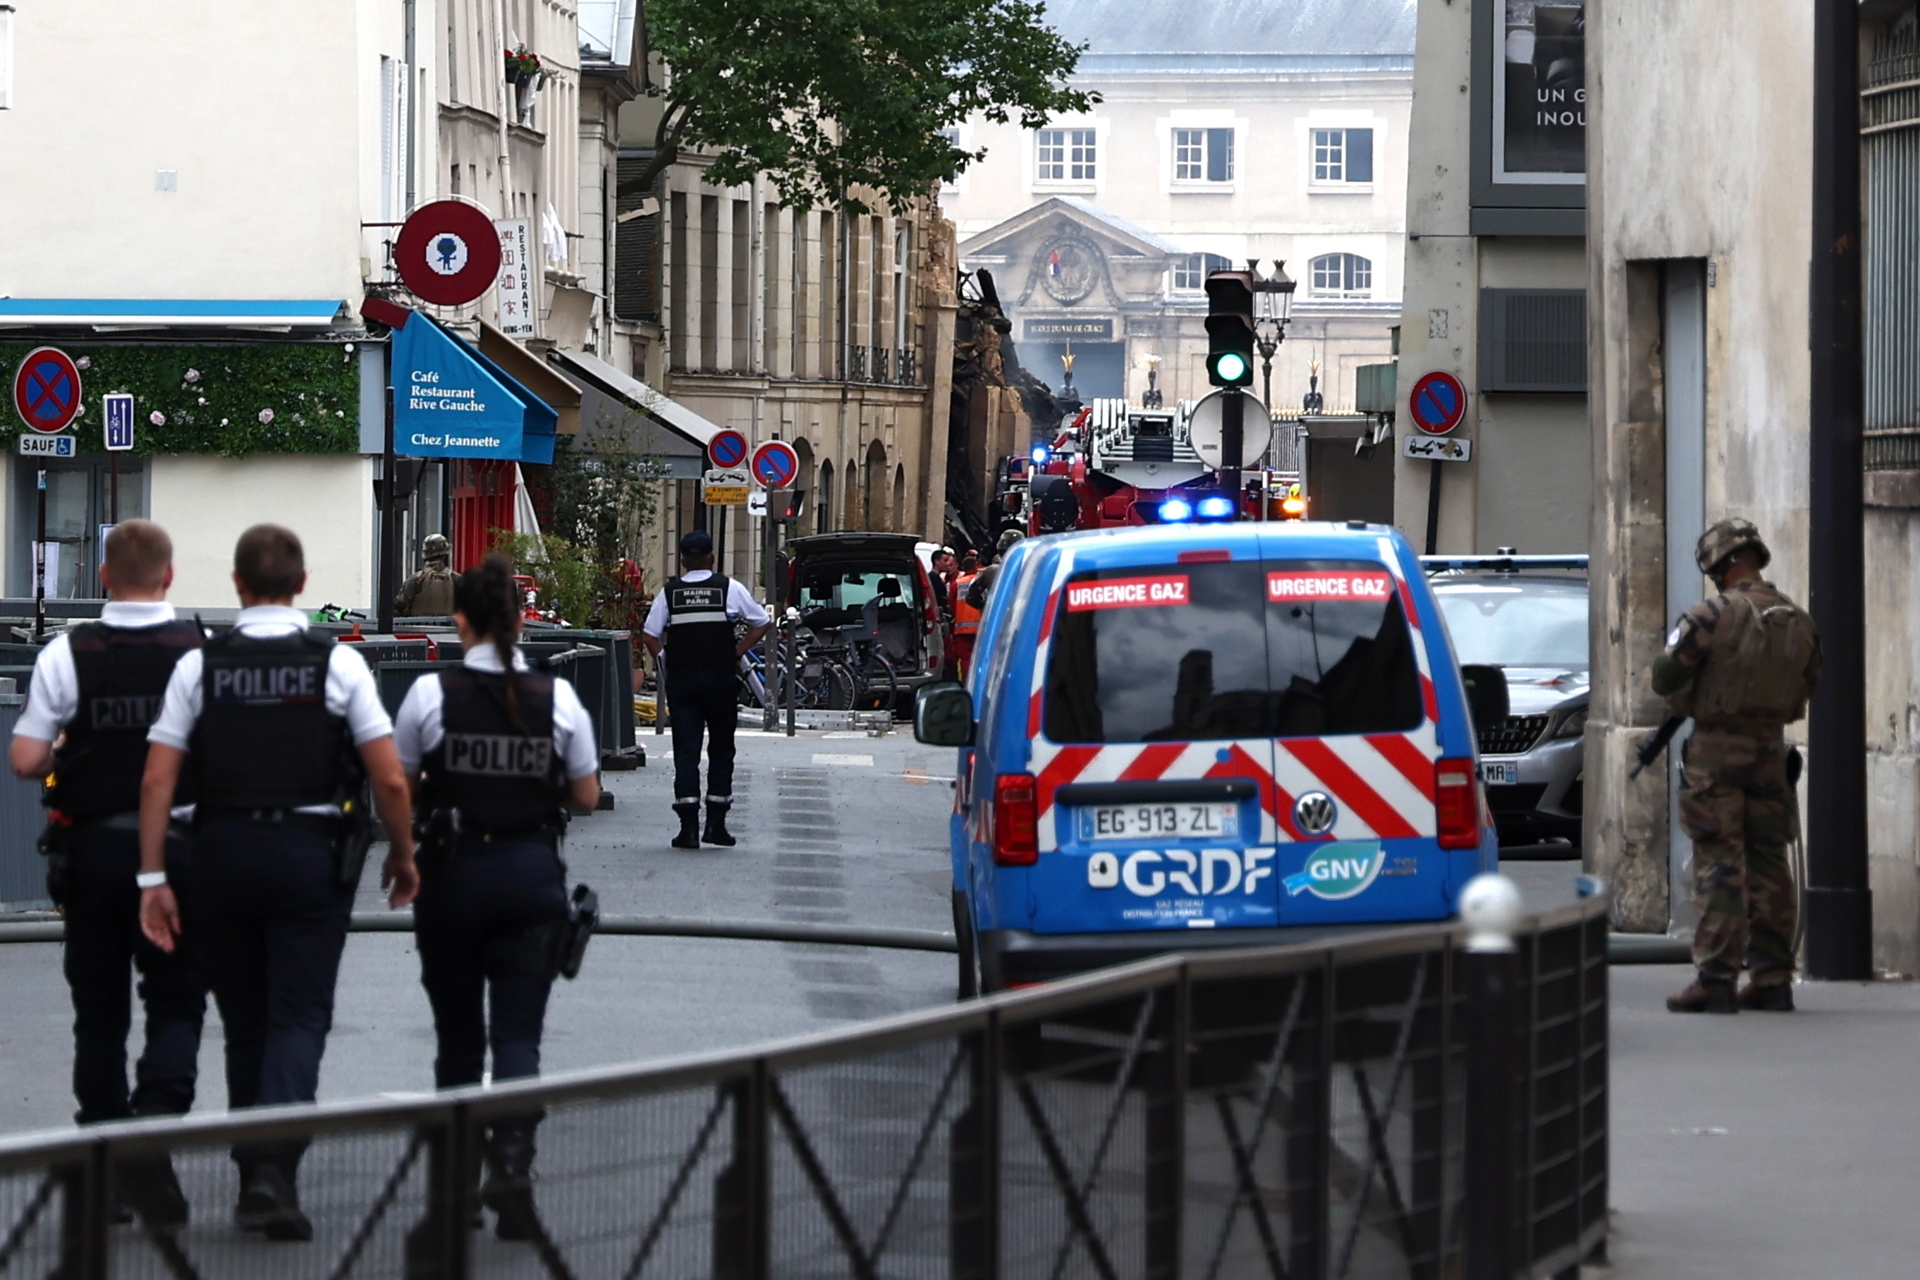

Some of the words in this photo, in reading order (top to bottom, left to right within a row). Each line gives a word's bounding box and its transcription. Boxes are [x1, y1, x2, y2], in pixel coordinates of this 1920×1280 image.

[1537, 88, 1565, 103] UN
[518, 225, 529, 318] RESTAURANT
[411, 371, 439, 383] Café
[411, 385, 475, 398] Restaurant
[409, 398, 437, 410] Rive
[439, 399, 486, 412] Gauche
[23, 439, 55, 451] SAUF
[411, 433, 442, 445] Chez
[443, 434, 500, 448] Jeannette
[1069, 584, 1146, 605] URGENCE
[1150, 582, 1184, 600] GAZ
[1270, 578, 1349, 597] URGENCE
[1352, 579, 1385, 595] GAZ
[213, 666, 316, 697] POLICE
[96, 698, 162, 726] POLI
[450, 738, 547, 773] POLICE
[1122, 847, 1276, 897] GRDF
[1310, 858, 1369, 880] GNV
